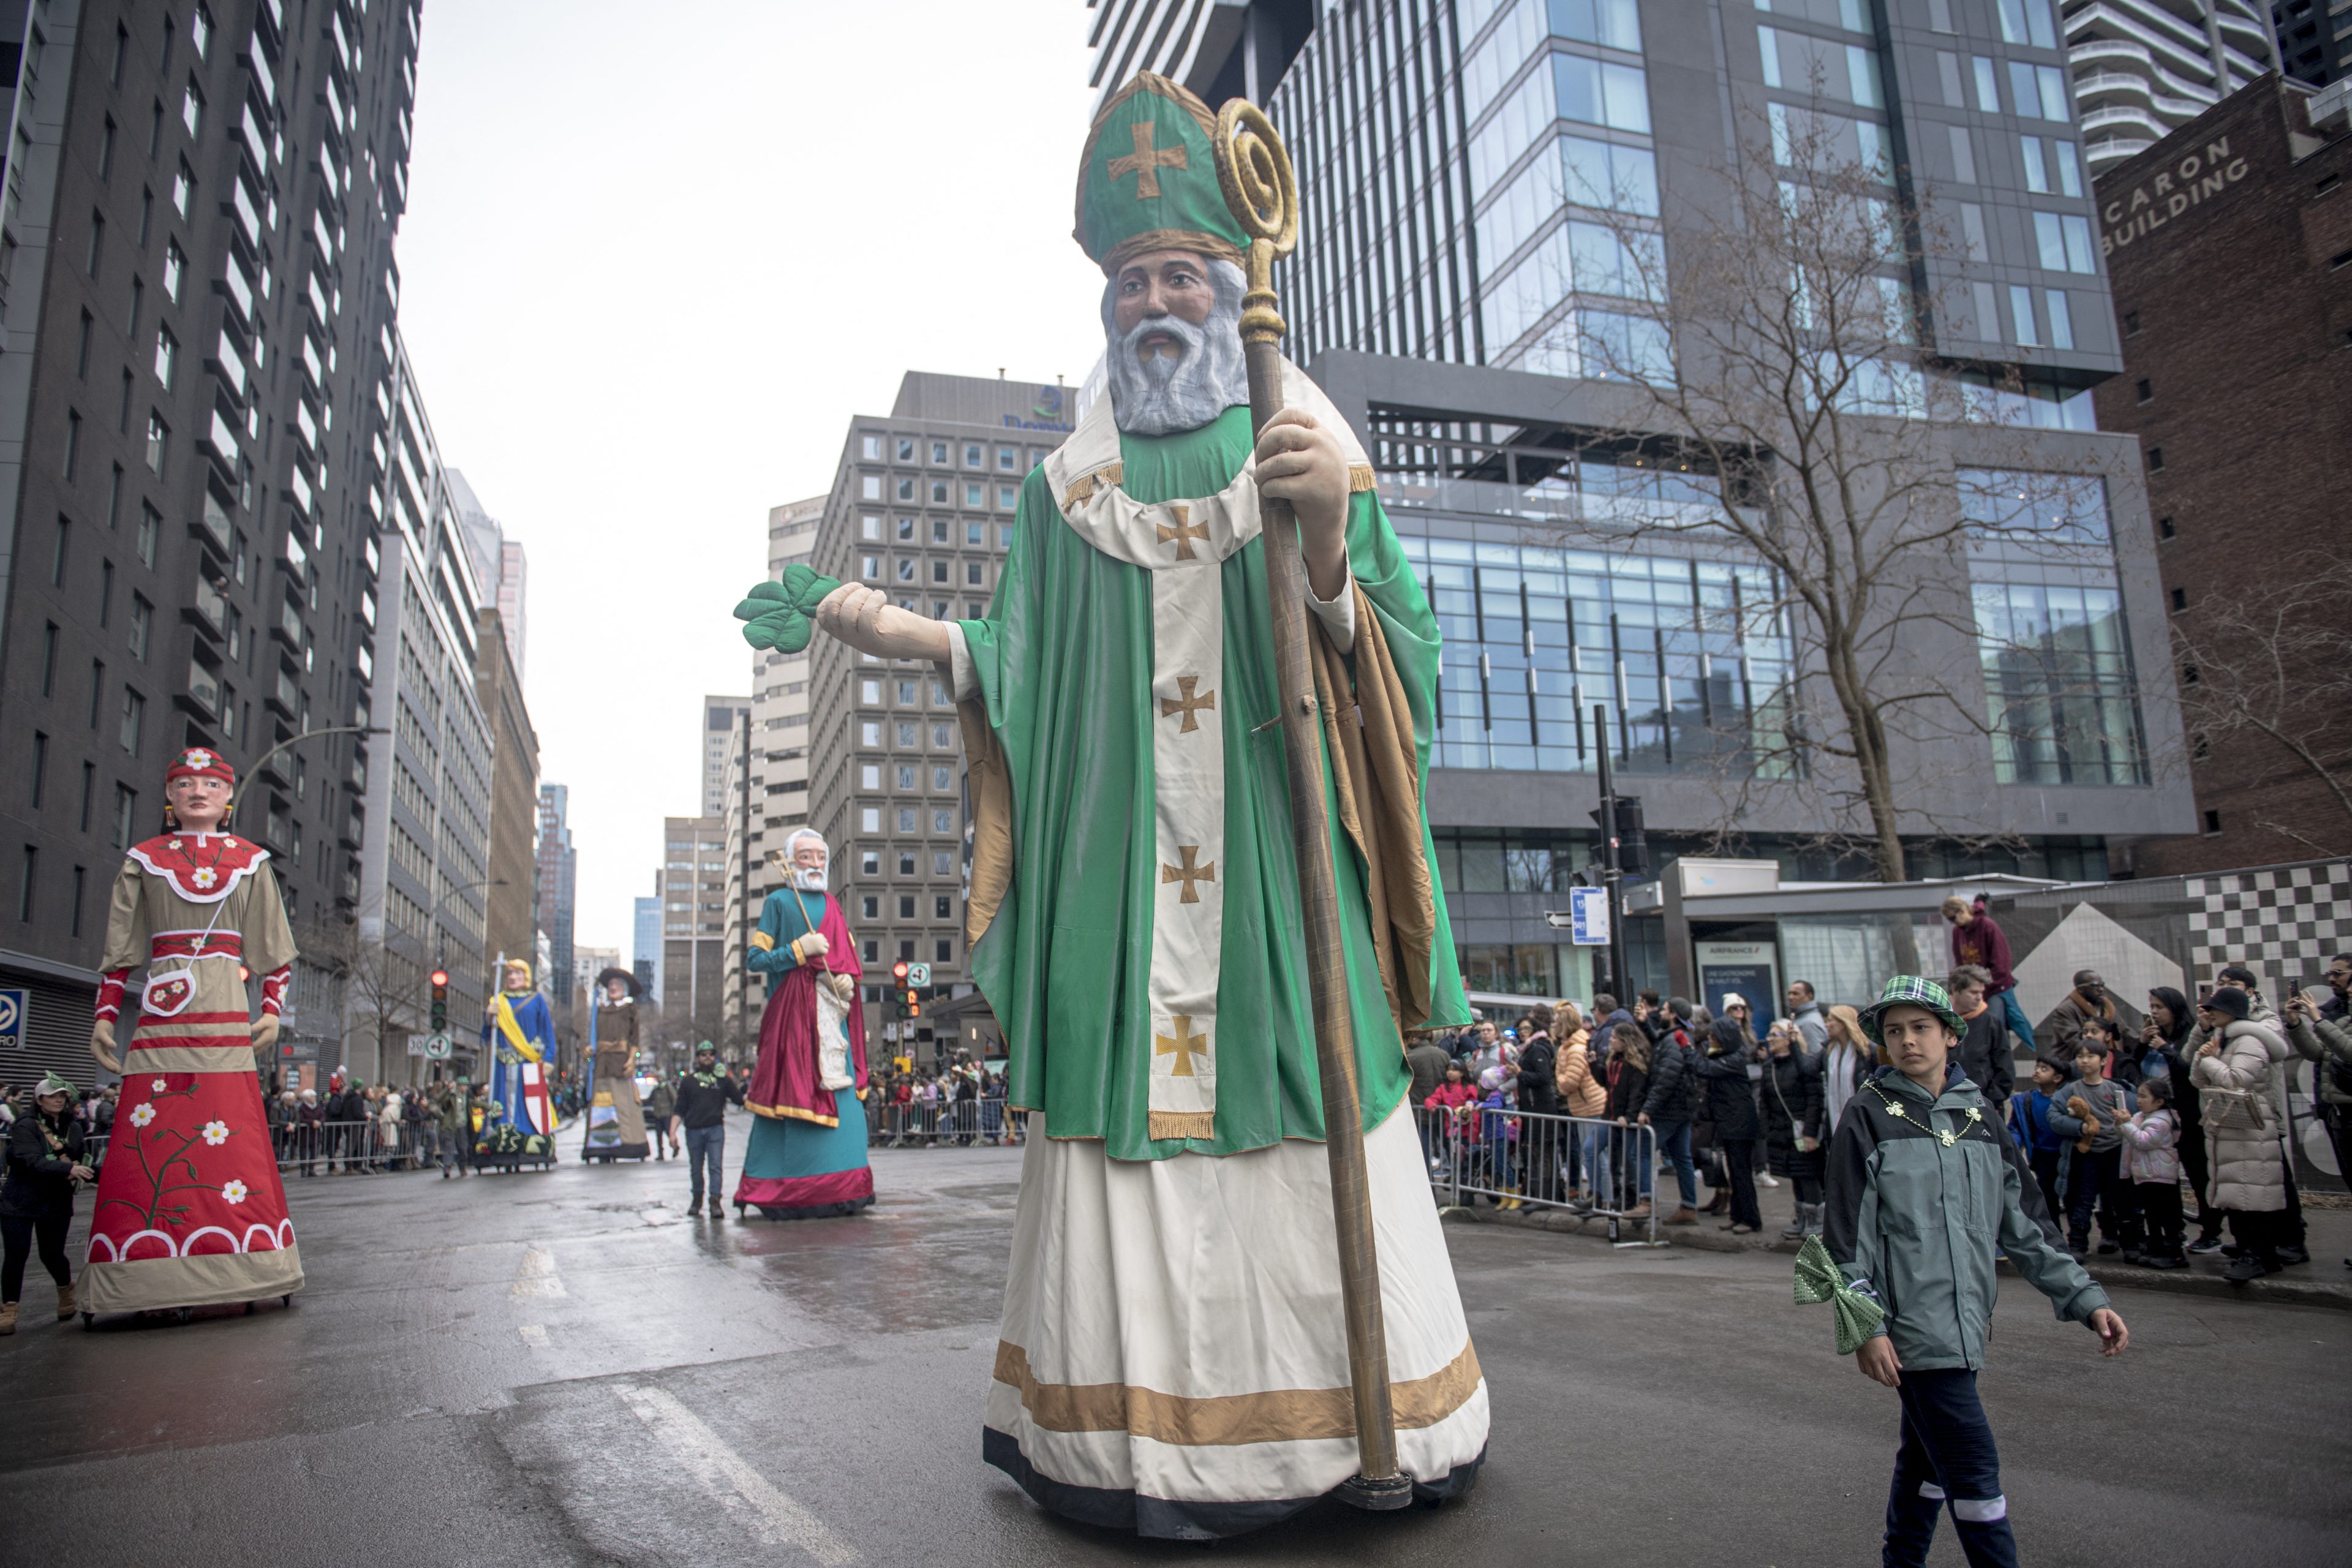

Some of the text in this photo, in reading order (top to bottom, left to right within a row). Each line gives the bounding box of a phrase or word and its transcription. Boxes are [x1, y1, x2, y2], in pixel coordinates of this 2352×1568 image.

[2105, 135, 2230, 224] CARON
[1574, 921, 1585, 931] 501
[409, 1038, 423, 1051] 30
